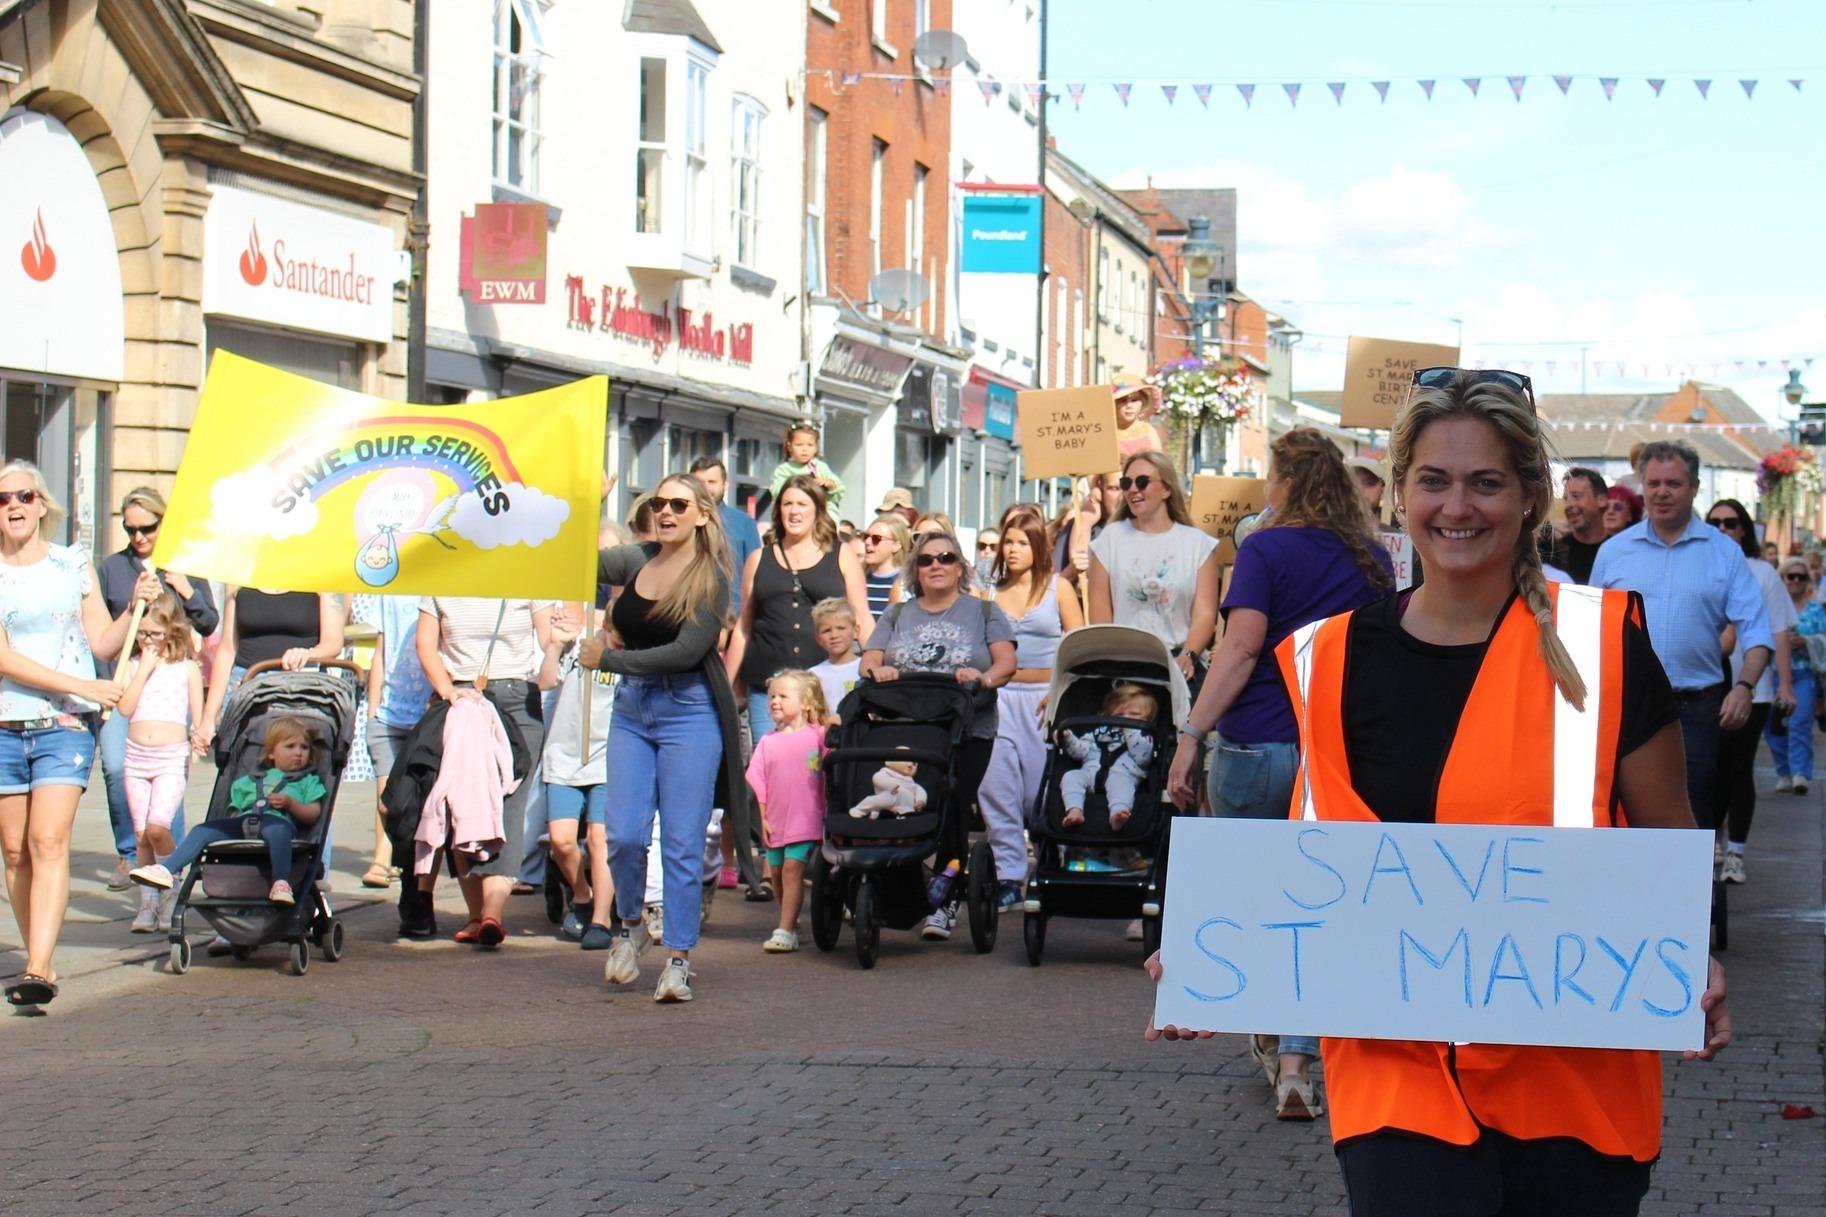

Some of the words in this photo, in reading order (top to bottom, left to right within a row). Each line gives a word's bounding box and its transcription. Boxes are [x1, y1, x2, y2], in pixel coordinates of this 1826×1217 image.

[273, 239, 375, 306] Santander
[480, 281, 536, 301] EWM
[565, 273, 596, 327] The
[1384, 358, 1417, 370] SAVE
[1051, 411, 1071, 422] I'M
[1076, 411, 1085, 420] A
[1055, 438, 1086, 449] BABY
[271, 448, 348, 514] SAVE
[354, 434, 416, 462] OUR
[422, 434, 510, 517] SERVICES
[1219, 500, 1239, 511] I'M
[1243, 502, 1252, 512] A
[1282, 828, 1550, 910] SAVE
[1184, 916, 1326, 1002] ST
[1399, 927, 1693, 1018] MARYS
